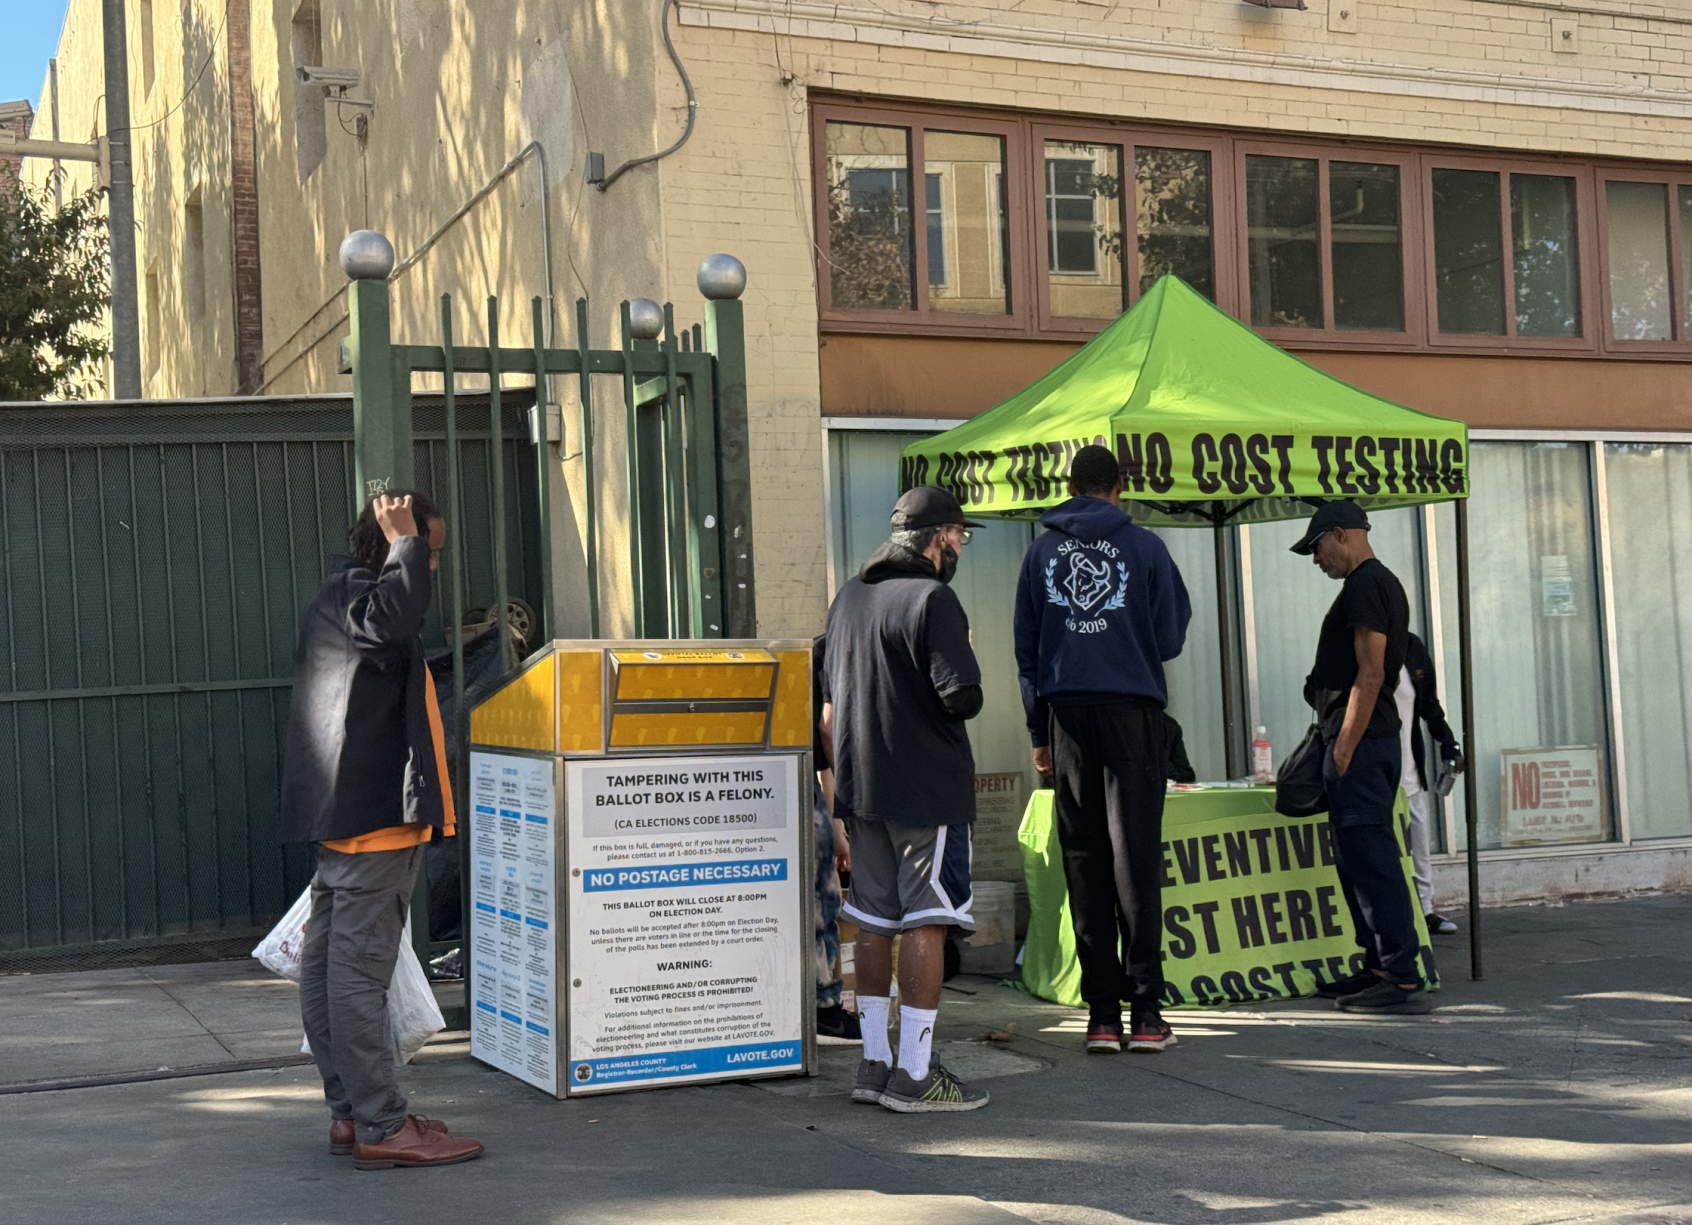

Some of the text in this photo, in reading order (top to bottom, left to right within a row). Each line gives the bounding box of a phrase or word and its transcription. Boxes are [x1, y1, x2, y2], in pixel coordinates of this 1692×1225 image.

[902, 435, 1107, 505] NO COST TESTIN
[1116, 432, 1465, 494] NO COST TESTING
[1058, 539, 1120, 558] SENORS
[1078, 618, 1107, 634] 2019
[606, 771, 763, 787] TAMPERING WITH THIS
[975, 777, 1015, 793] OPERTY
[1511, 761, 1541, 810] NO
[596, 788, 774, 806] BALLOT BOX IS A FELONY.
[614, 813, 757, 830] (CA ELECTIONS CODE 18500)
[636, 842, 649, 850] full,
[651, 841, 683, 849] damaged,
[701, 839, 713, 847] you
[745, 836, 778, 844] questions,
[631, 851, 657, 859] contact
[735, 846, 757, 854] Option
[1161, 822, 1336, 888] EVENTIVE
[591, 863, 781, 886] NO POSTAGE NECESSARY
[603, 902, 621, 910] THIS
[624, 900, 655, 909] BALLOT
[657, 899, 674, 907] BOX
[698, 896, 724, 904] CLOSE
[738, 893, 767, 902] 8:00PM
[649, 910, 662, 918] ON
[664, 908, 703, 917] ELECTION
[651, 923, 682, 931] accepted
[1161, 885, 1342, 962] ST HERE
[616, 935, 633, 943] there
[755, 925, 778, 934] closing
[628, 944, 645, 953] polls
[660, 941, 677, 949] been
[679, 940, 709, 948] extended
[657, 960, 712, 971] WARNING:
[610, 976, 758, 994] ELECTIONEERING AND/OR CORRUPTING
[1163, 980, 1186, 1005] O
[1190, 962, 1301, 1004] COST
[631, 994, 660, 1003] VOTING
[662, 991, 696, 1000] PROCESS
[707, 986, 753, 996] PROHIBITED!
[604, 1010, 638, 1018] Violations
[640, 1008, 664, 1017] subject
[692, 1003, 715, 1011] and/or
[717, 1000, 762, 1009] imprisonment.
[618, 1023, 652, 1031] additional
[653, 1020, 691, 1028] information
[716, 1014, 754, 1024] prohibitions
[592, 1045, 614, 1053] voting
[615, 1043, 643, 1051] process,
[645, 1041, 667, 1049] please
[732, 1030, 775, 1039] LAVOTE.GOV.
[596, 1033, 645, 1043] electioneering
[646, 1031, 659, 1039] and
[679, 1026, 715, 1035] constitutes
[717, 1023, 750, 1032] corruption
[640, 1058, 666, 1066] COUNTY
[727, 1048, 794, 1063] LAVOTE.GOV
